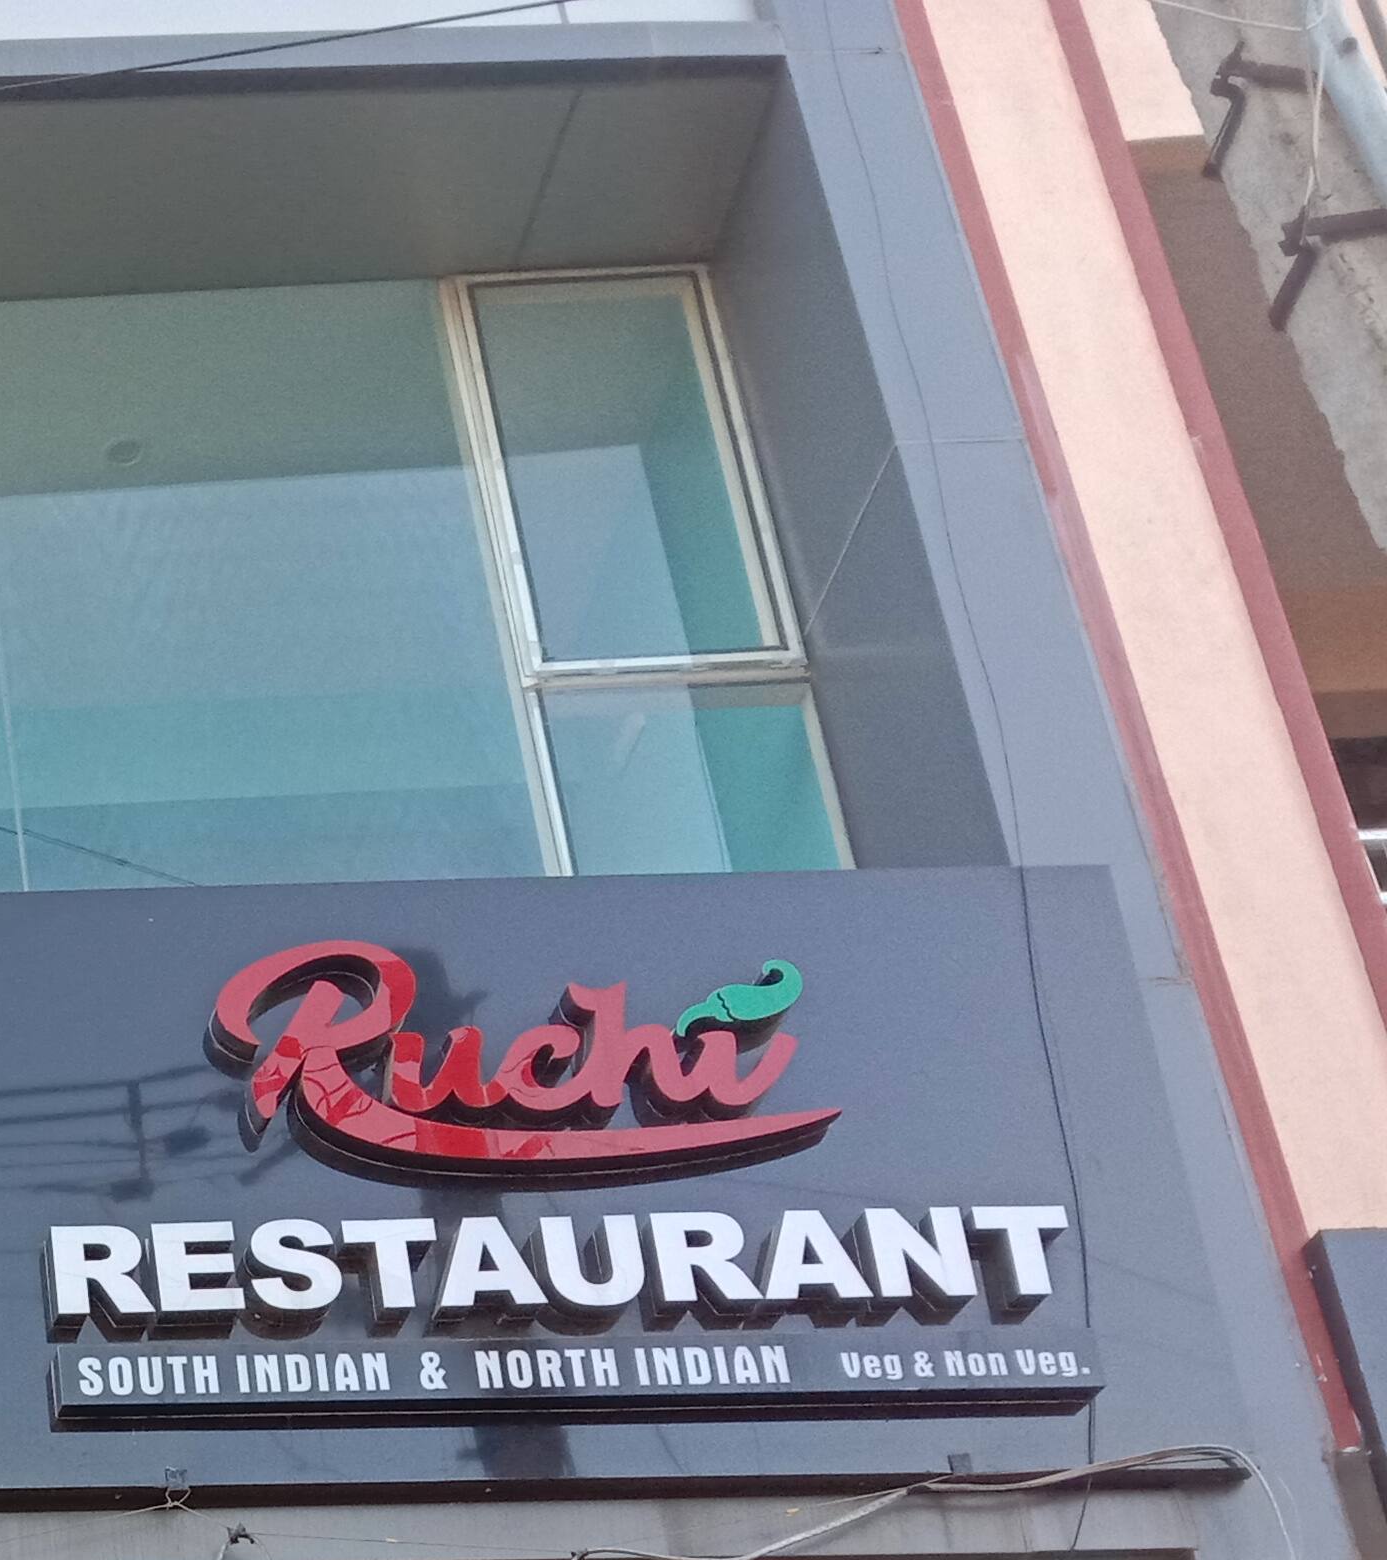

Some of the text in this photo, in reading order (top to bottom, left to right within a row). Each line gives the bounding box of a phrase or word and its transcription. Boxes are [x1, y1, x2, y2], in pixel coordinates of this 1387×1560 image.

[216, 939, 841, 1160] Ruchi
[50, 1205, 1067, 1316] RESTAURANT
[78, 1354, 219, 1396] SOUTH
[237, 1351, 390, 1394] INDIAN
[420, 1350, 447, 1391] &
[475, 1348, 621, 1390] NORTH
[634, 1344, 791, 1386] INDIAN
[839, 1350, 904, 1381] Veg
[912, 1350, 937, 1378] &
[944, 1348, 1008, 1378] Non
